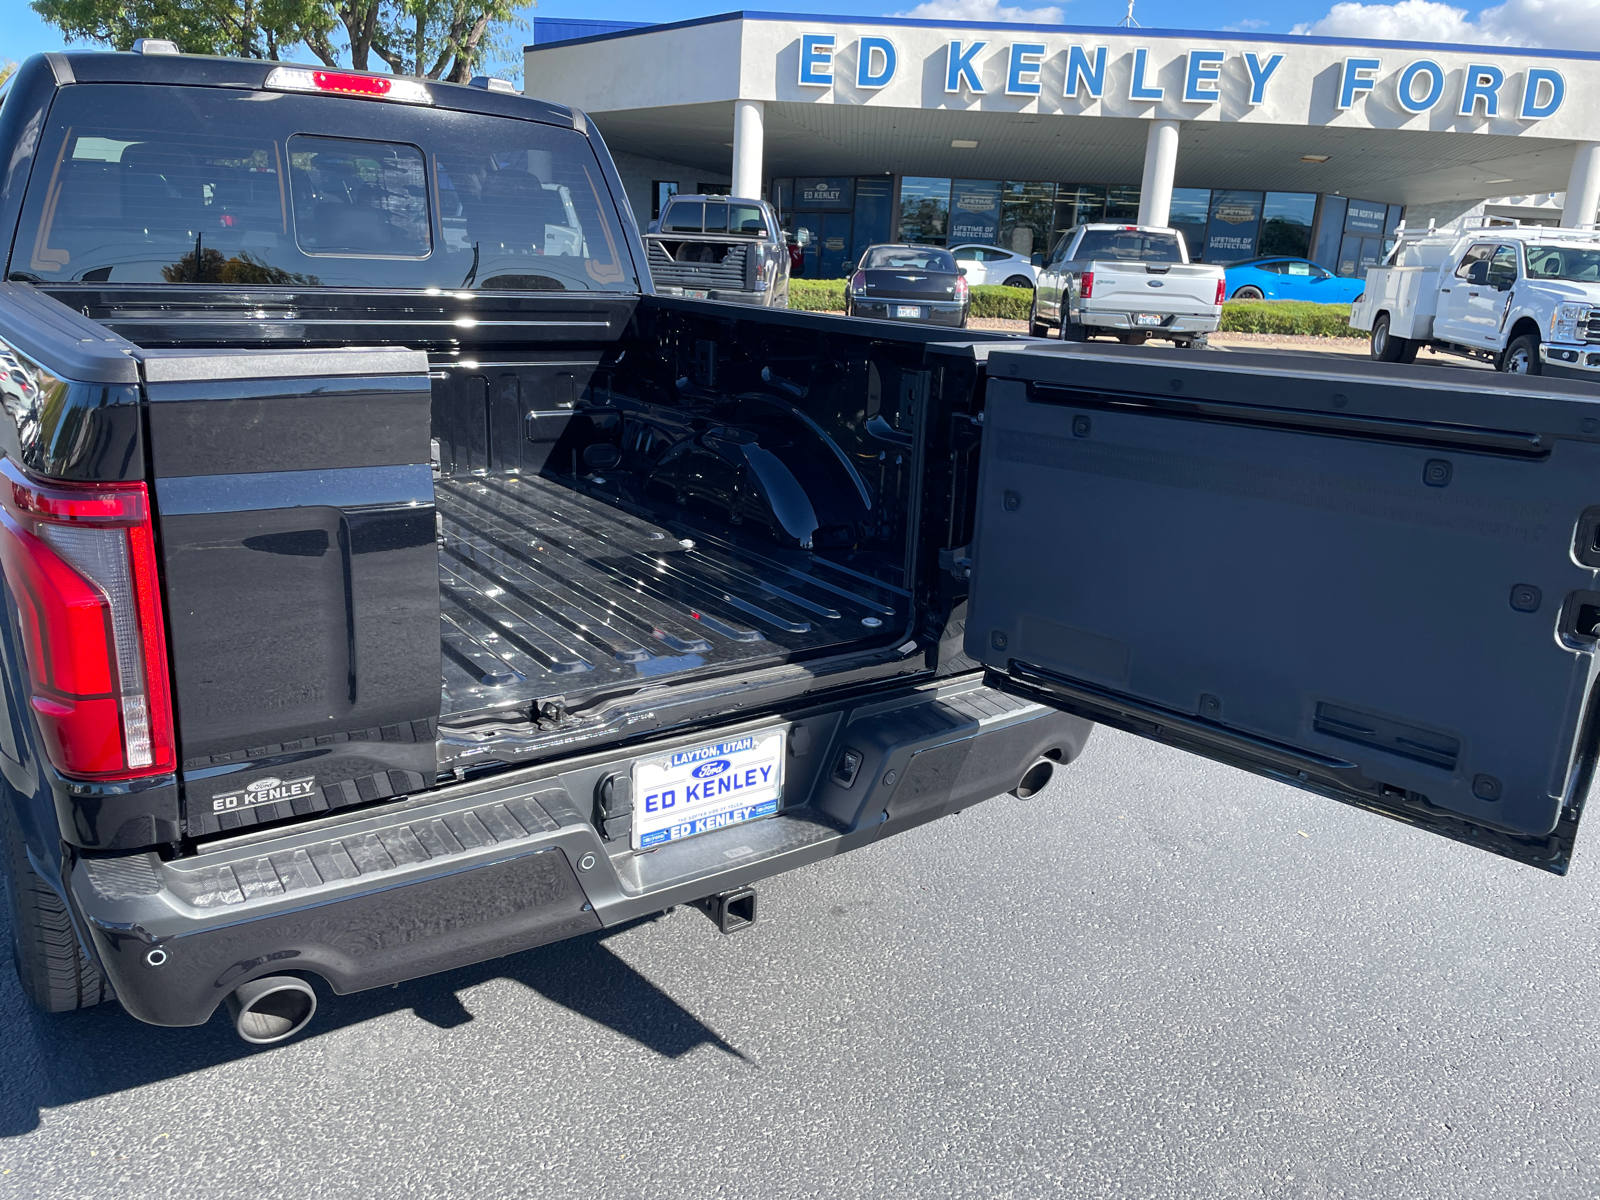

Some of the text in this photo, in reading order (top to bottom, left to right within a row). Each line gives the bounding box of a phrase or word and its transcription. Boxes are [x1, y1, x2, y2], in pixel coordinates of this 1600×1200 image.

[799, 33, 1566, 119] ED KENLEY FORD
[804, 191, 840, 199] ED KENLEY
[1359, 209, 1374, 219] NORTH
[953, 225, 983, 233] LIFETIME
[952, 230, 994, 239] PROTECTION
[1210, 236, 1242, 244] LIFETIME
[1209, 242, 1252, 250] PROTECTION
[673, 738, 751, 766] LAYTON, UTAH
[698, 761, 725, 778] Ford
[254, 781, 275, 790] Ford
[645, 764, 773, 813] ED KENLEY
[213, 780, 314, 811] ED KENLEY
[670, 806, 752, 841] ED KENLEY
